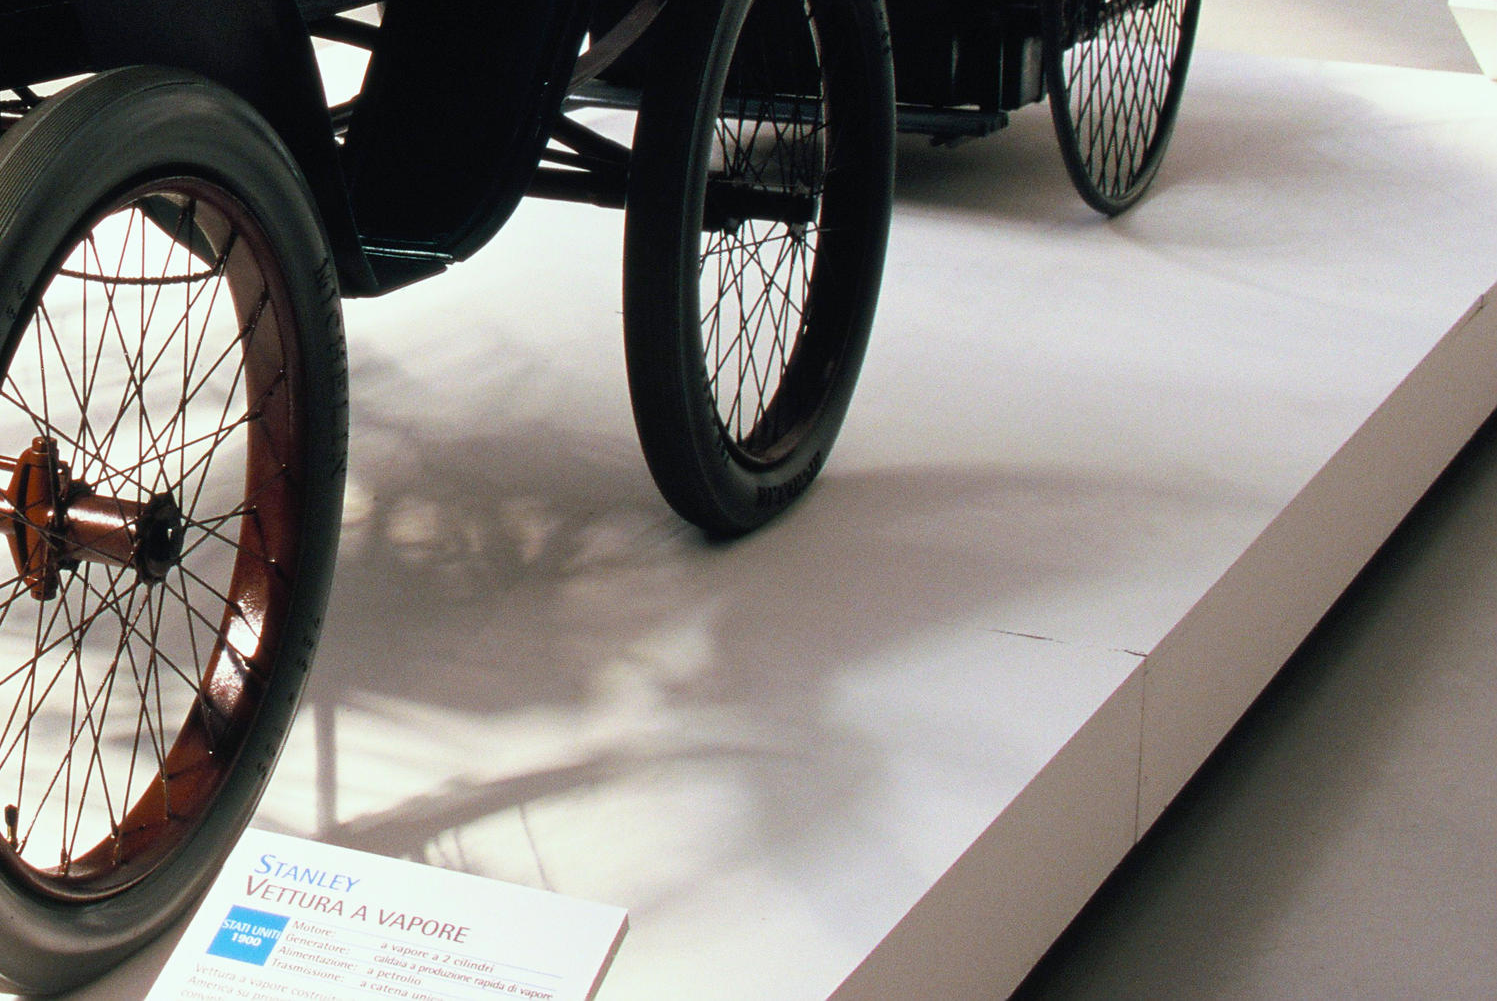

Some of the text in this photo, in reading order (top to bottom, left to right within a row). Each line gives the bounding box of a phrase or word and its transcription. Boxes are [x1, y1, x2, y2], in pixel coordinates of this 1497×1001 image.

[254, 854, 361, 892] STANLEY
[222, 918, 283, 941] STATI UNITI
[246, 875, 471, 944] VETTURA A VAPORE
[231, 932, 262, 948] 1900
[292, 920, 495, 974] Motore: a vapore a 2 cilindri
[195, 963, 237, 982] Vettura
[249, 977, 289, 993] vapore
[271, 957, 345, 984] Trasmissione:
[359, 980, 368, 989] a
[370, 982, 409, 998] catena
[278, 945, 422, 987] Alimentazione: a petrolio
[285, 933, 554, 1001] Generatore: caldaia a produzione rapida di vapore
